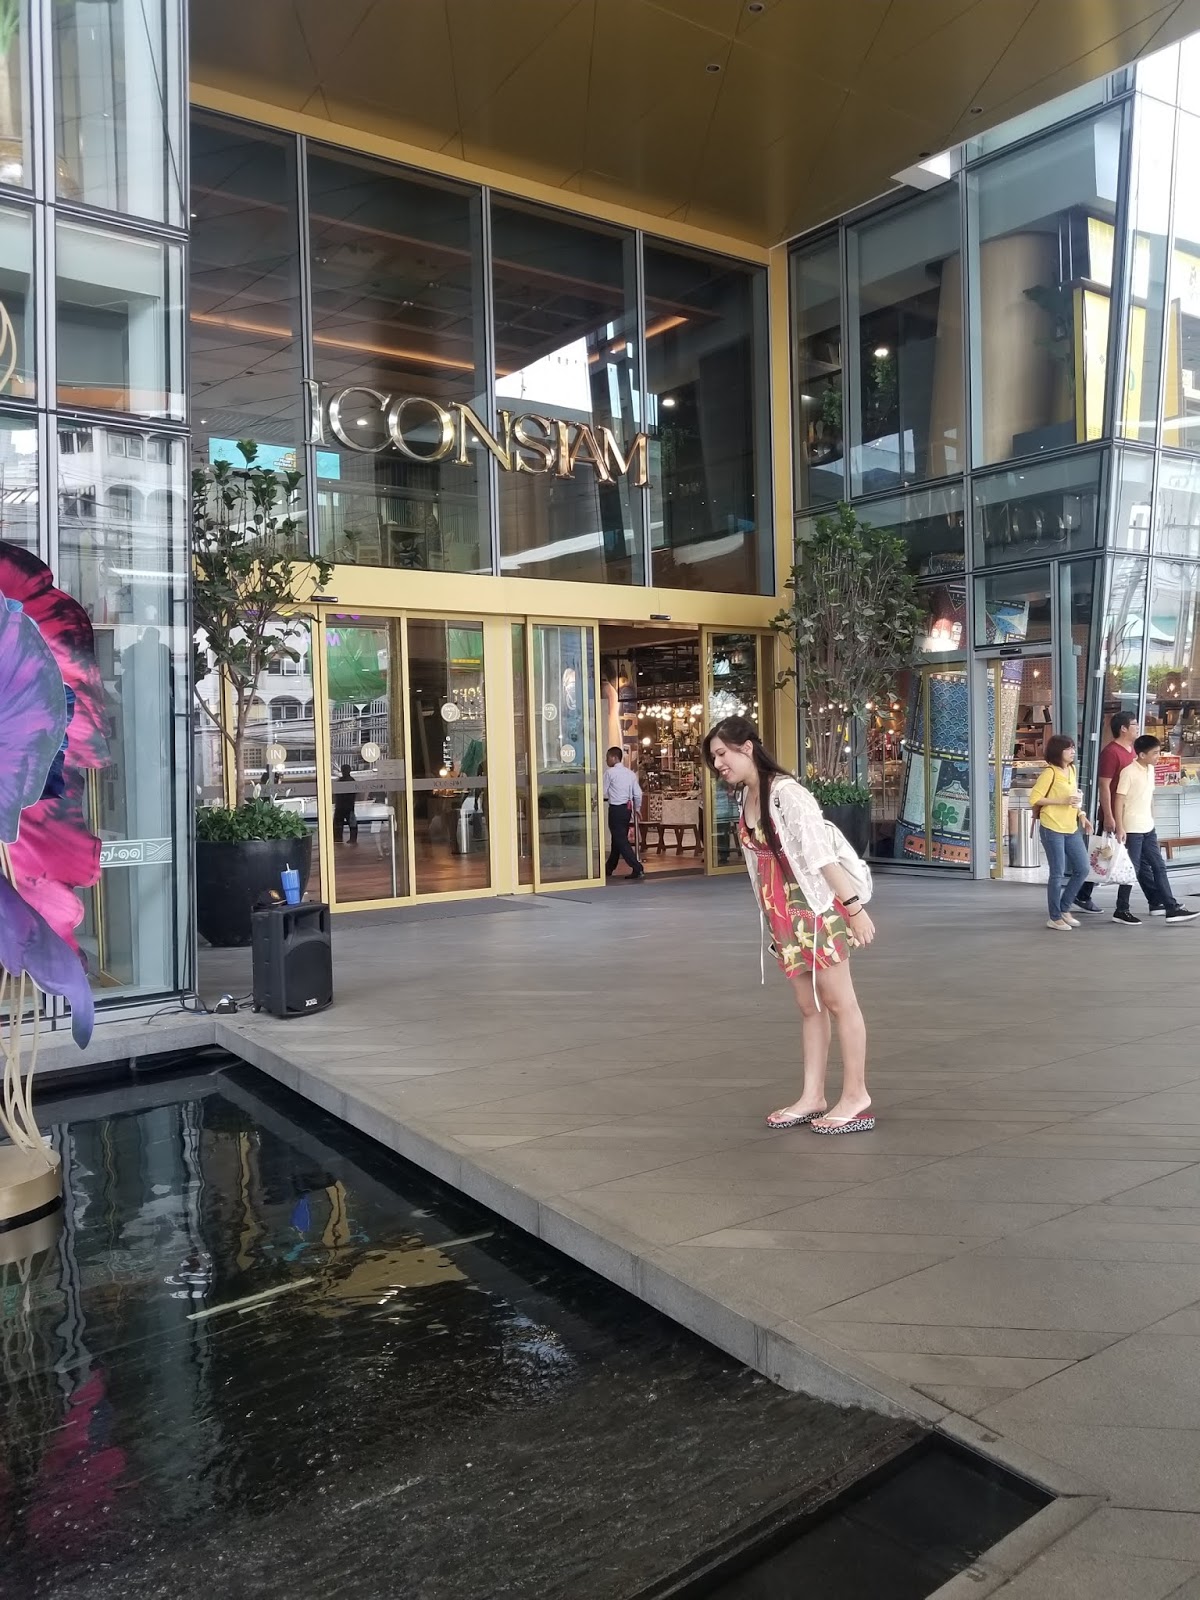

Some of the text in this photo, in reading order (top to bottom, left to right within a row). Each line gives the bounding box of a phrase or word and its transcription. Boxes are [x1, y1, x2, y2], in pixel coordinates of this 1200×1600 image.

[302, 378, 653, 488] ICONSIAM
[270, 749, 282, 760] IN
[365, 747, 376, 757] IN
[561, 749, 576, 758] OUT
